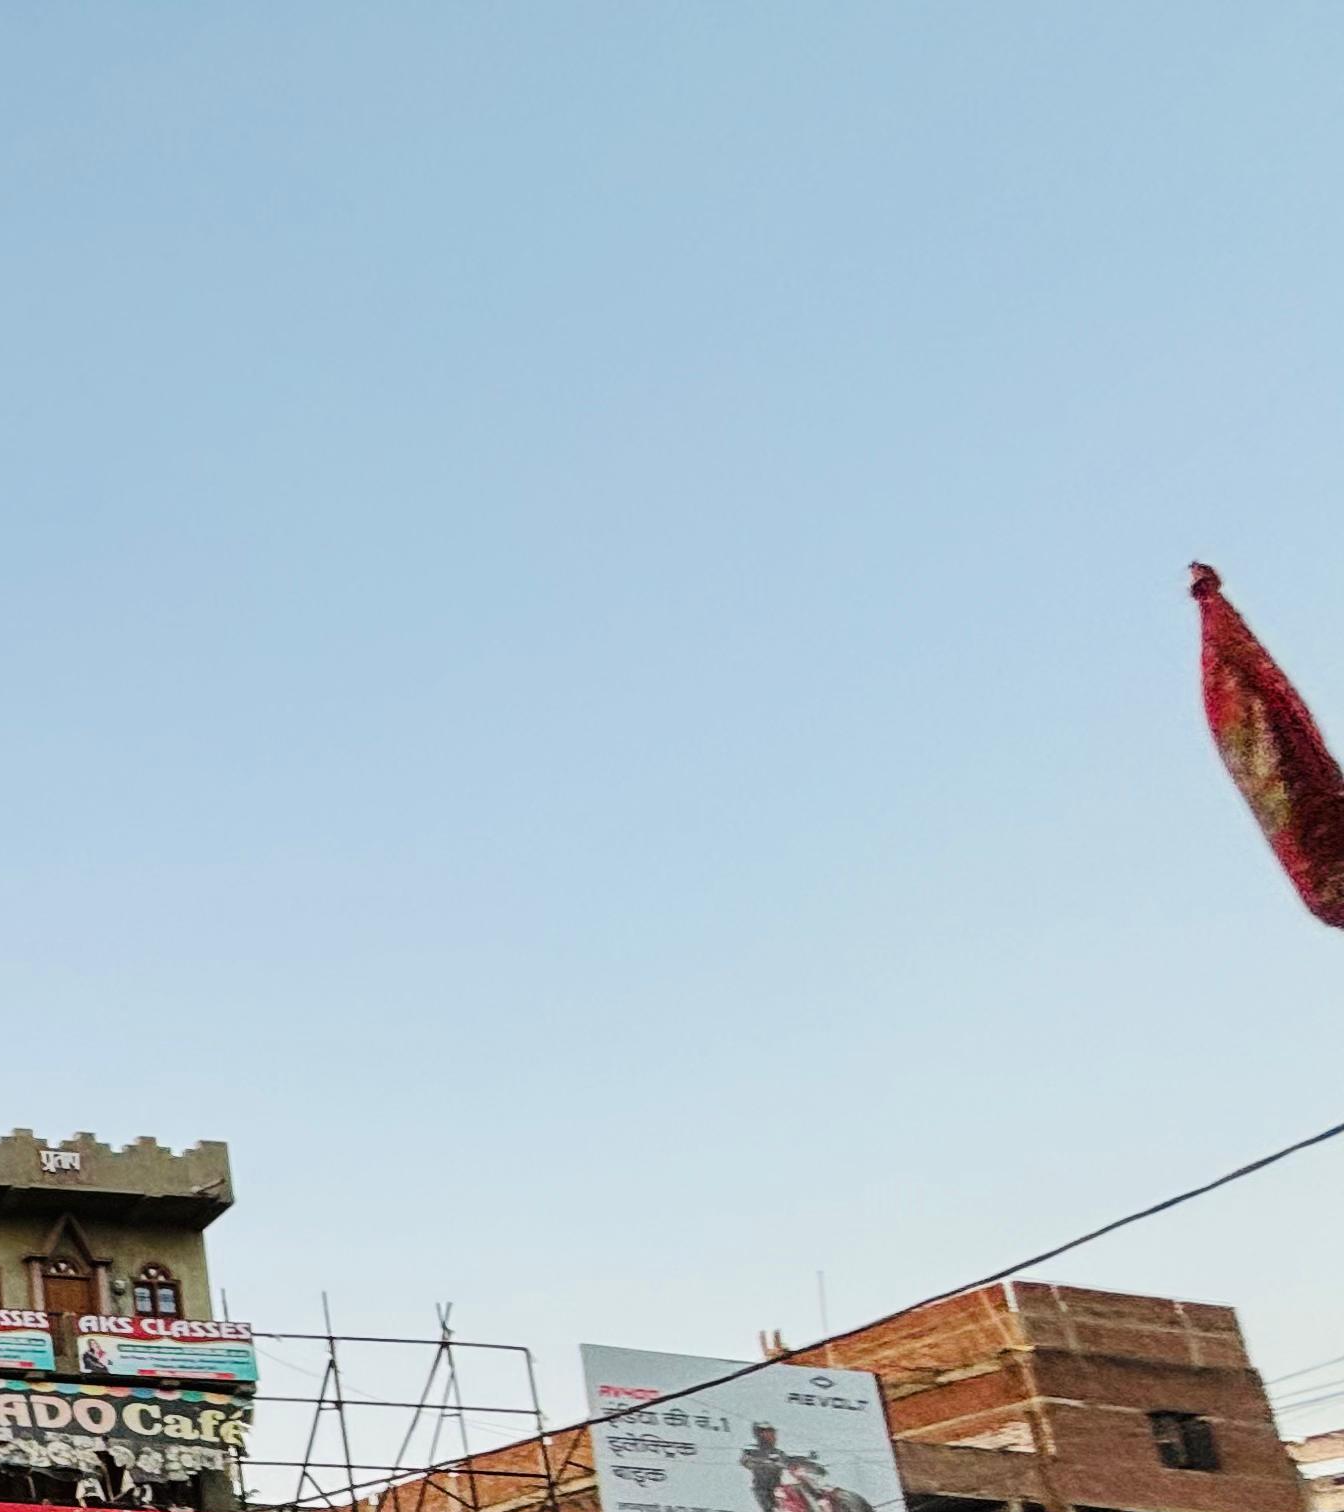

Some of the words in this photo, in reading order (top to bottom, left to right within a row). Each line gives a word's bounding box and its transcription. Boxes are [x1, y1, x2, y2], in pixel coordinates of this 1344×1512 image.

[78, 1315, 134, 1334] AKS
[140, 1318, 252, 1339] CLASSES
[122, 1402, 247, 1446] Café
